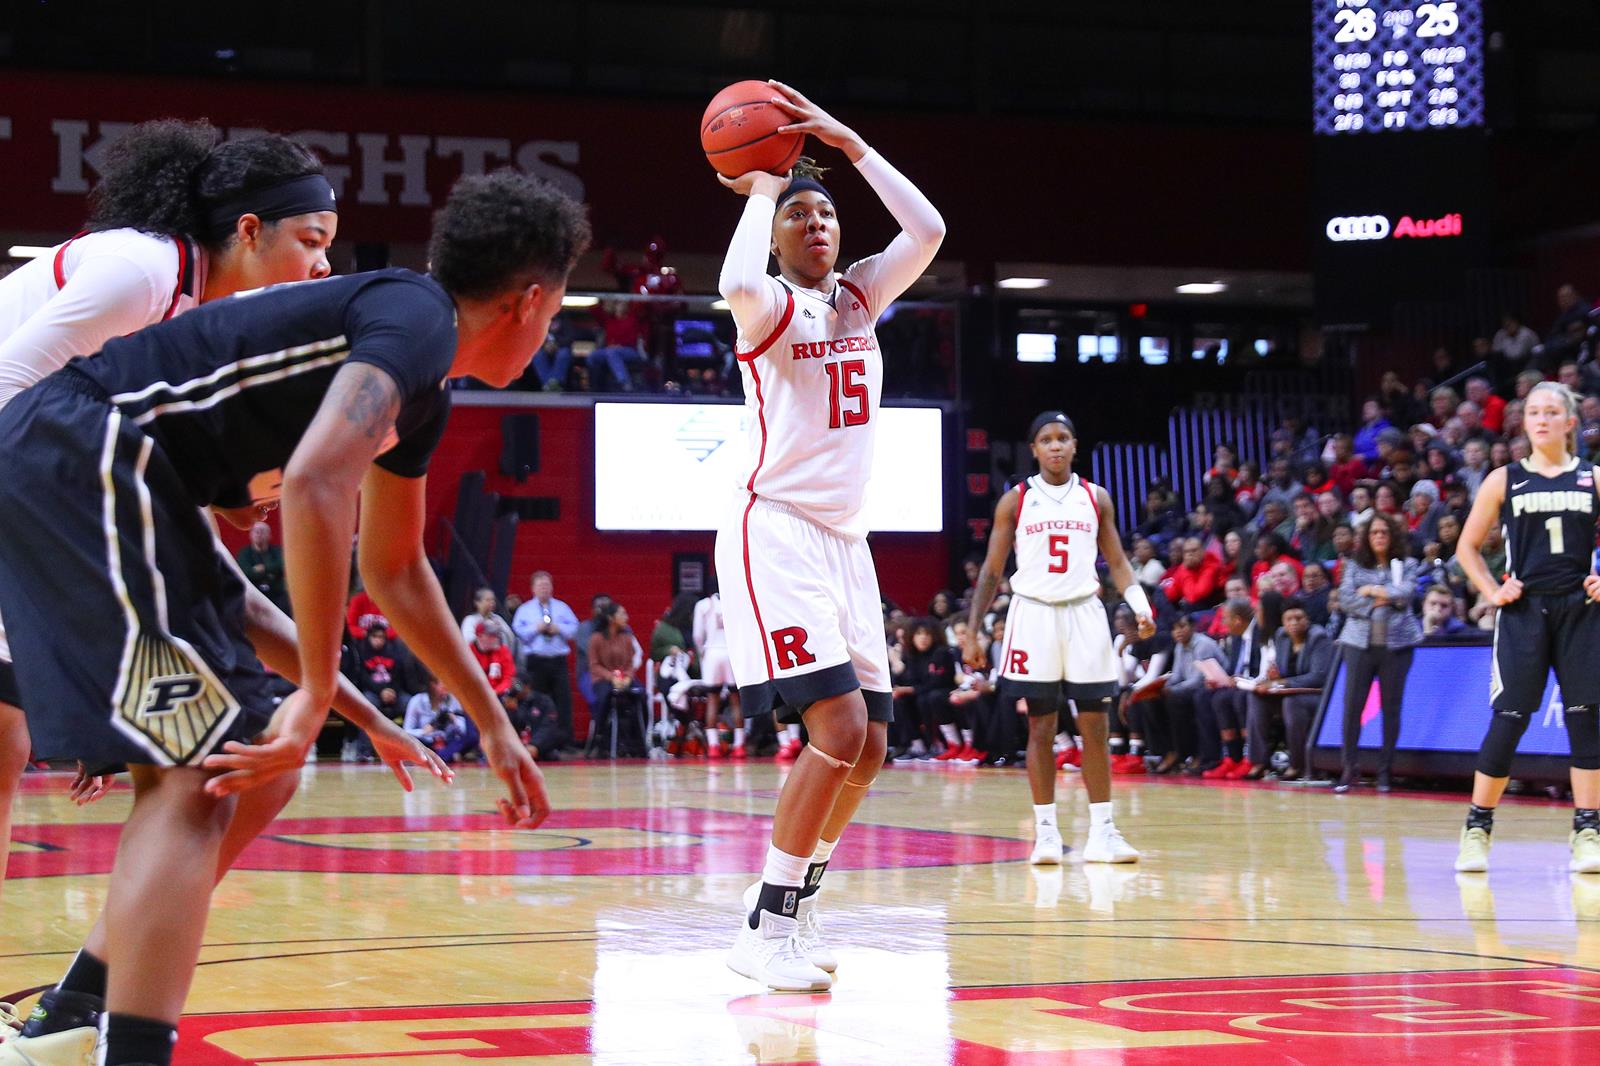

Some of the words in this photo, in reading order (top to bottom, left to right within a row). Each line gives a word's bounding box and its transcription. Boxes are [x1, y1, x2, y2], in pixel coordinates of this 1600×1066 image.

[1416, 2, 1459, 37] 25
[1393, 213, 1462, 238] Audi
[825, 359, 870, 429] 15
[1511, 491, 1593, 517] PURDUE
[1025, 520, 1092, 535] RUTGERS
[1545, 516, 1564, 554] 1
[1048, 534, 1069, 574] 5
[770, 626, 817, 670] R
[1009, 649, 1029, 675] R
[144, 673, 206, 717] P
